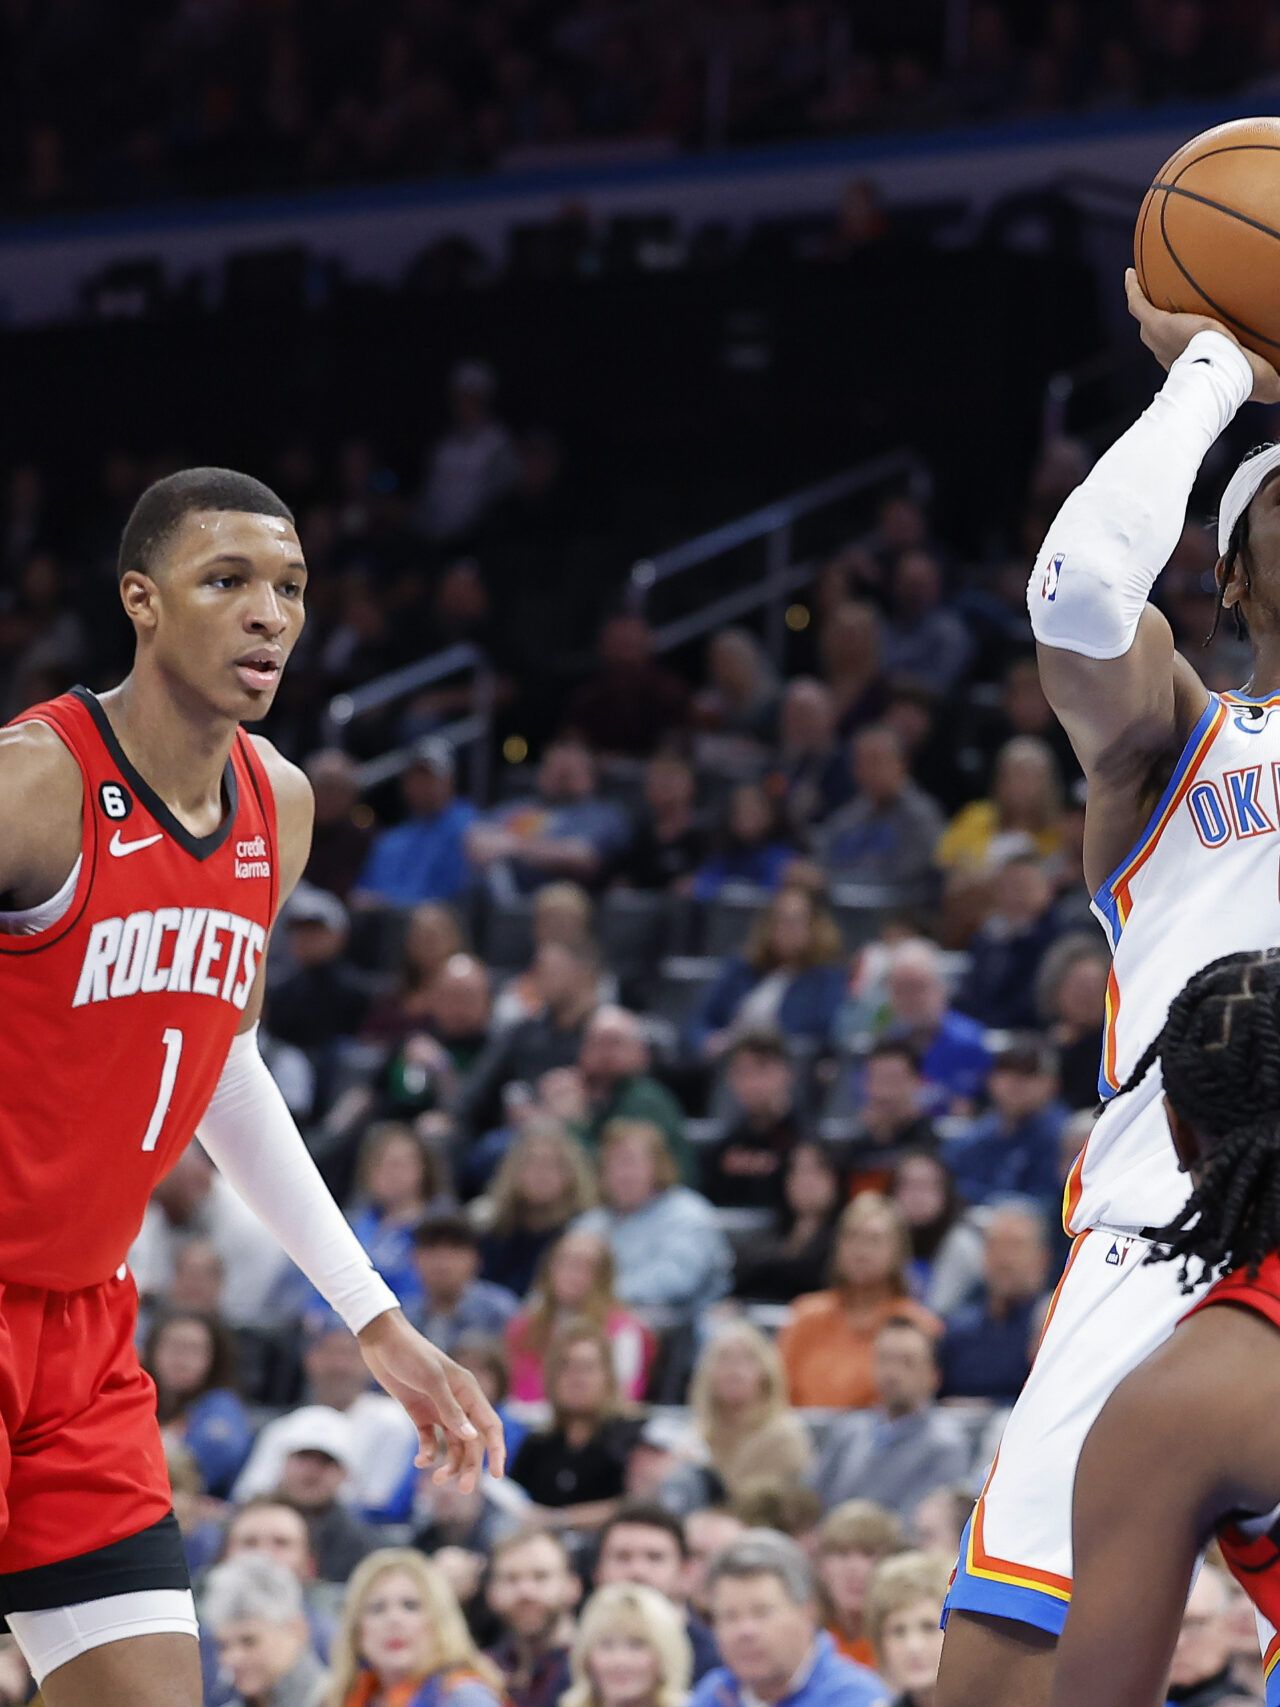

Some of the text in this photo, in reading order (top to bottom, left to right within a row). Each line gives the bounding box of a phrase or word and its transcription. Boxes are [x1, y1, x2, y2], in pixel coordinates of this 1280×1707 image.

[101, 785, 127, 818] 6
[236, 835, 266, 857] credit
[234, 858, 271, 878] karma
[71, 907, 268, 1010] ROCKETS
[142, 1028, 183, 1151] 1
